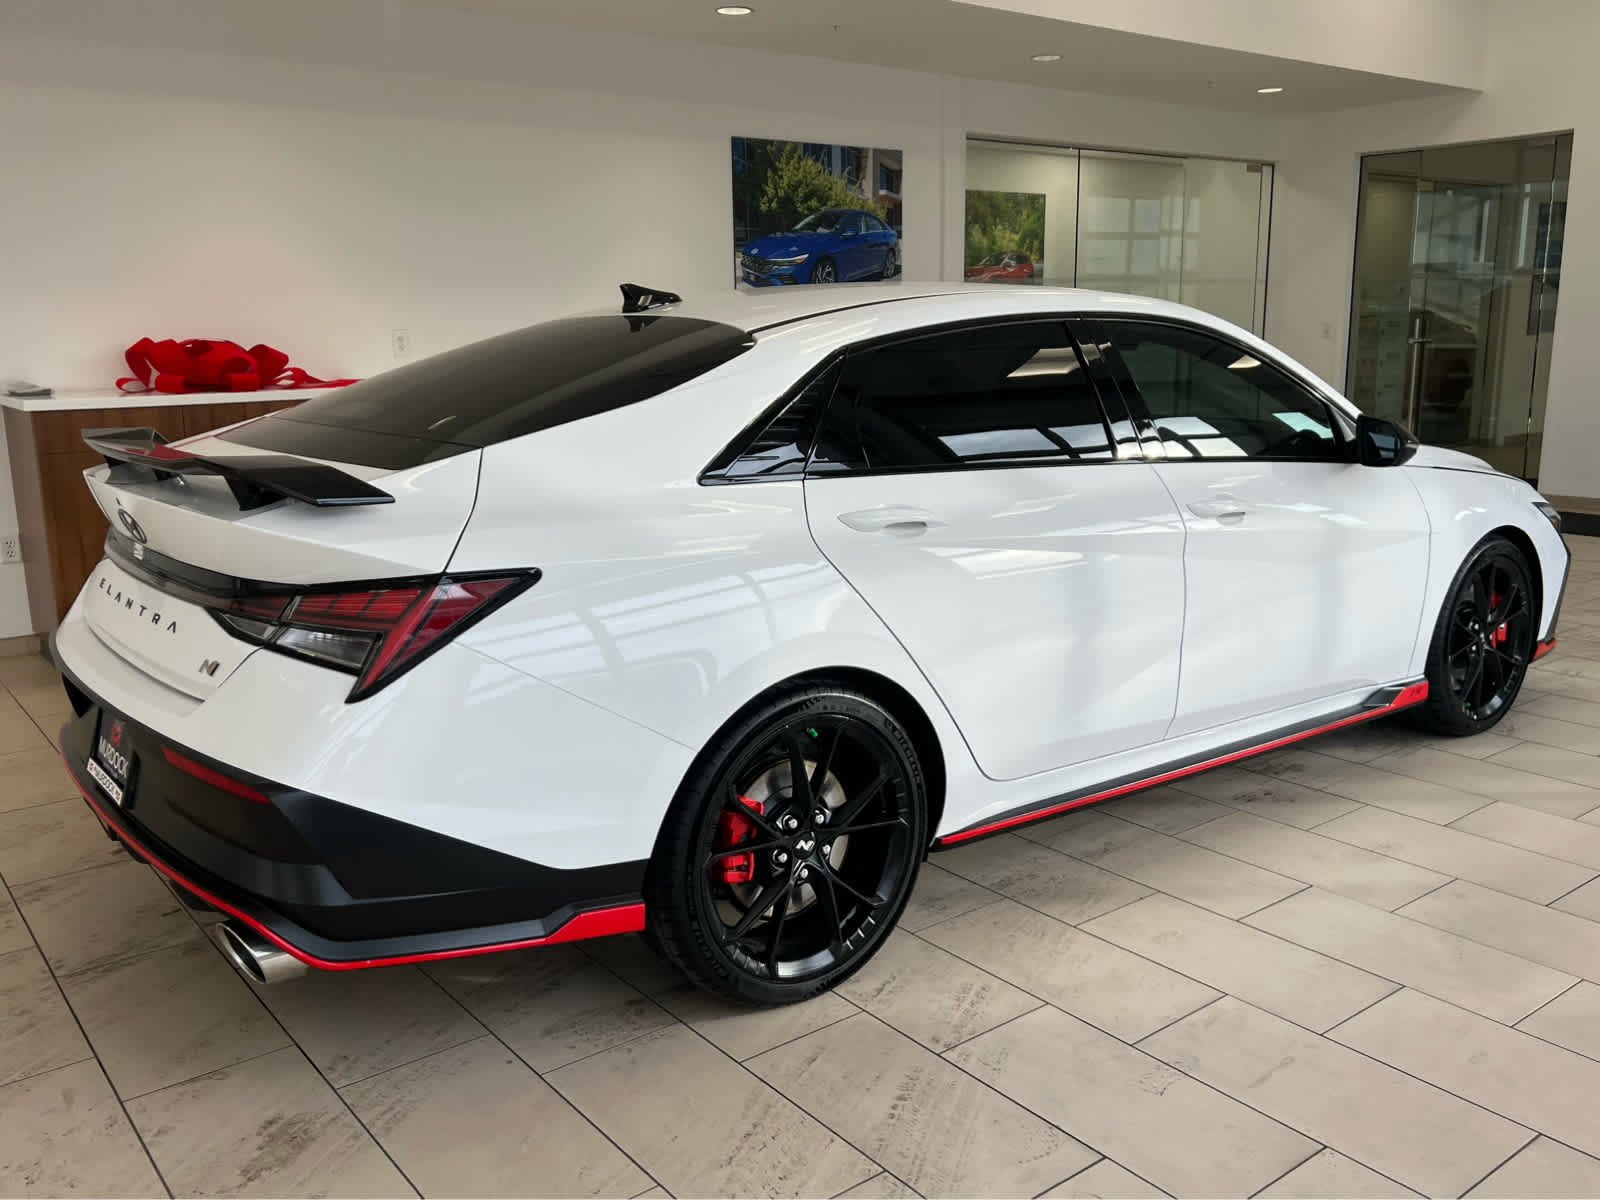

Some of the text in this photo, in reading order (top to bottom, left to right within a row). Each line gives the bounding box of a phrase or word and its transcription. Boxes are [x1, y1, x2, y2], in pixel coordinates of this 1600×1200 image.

[99, 577, 178, 634] ELANTRA
[198, 658, 221, 677] N
[795, 839, 815, 851] N
